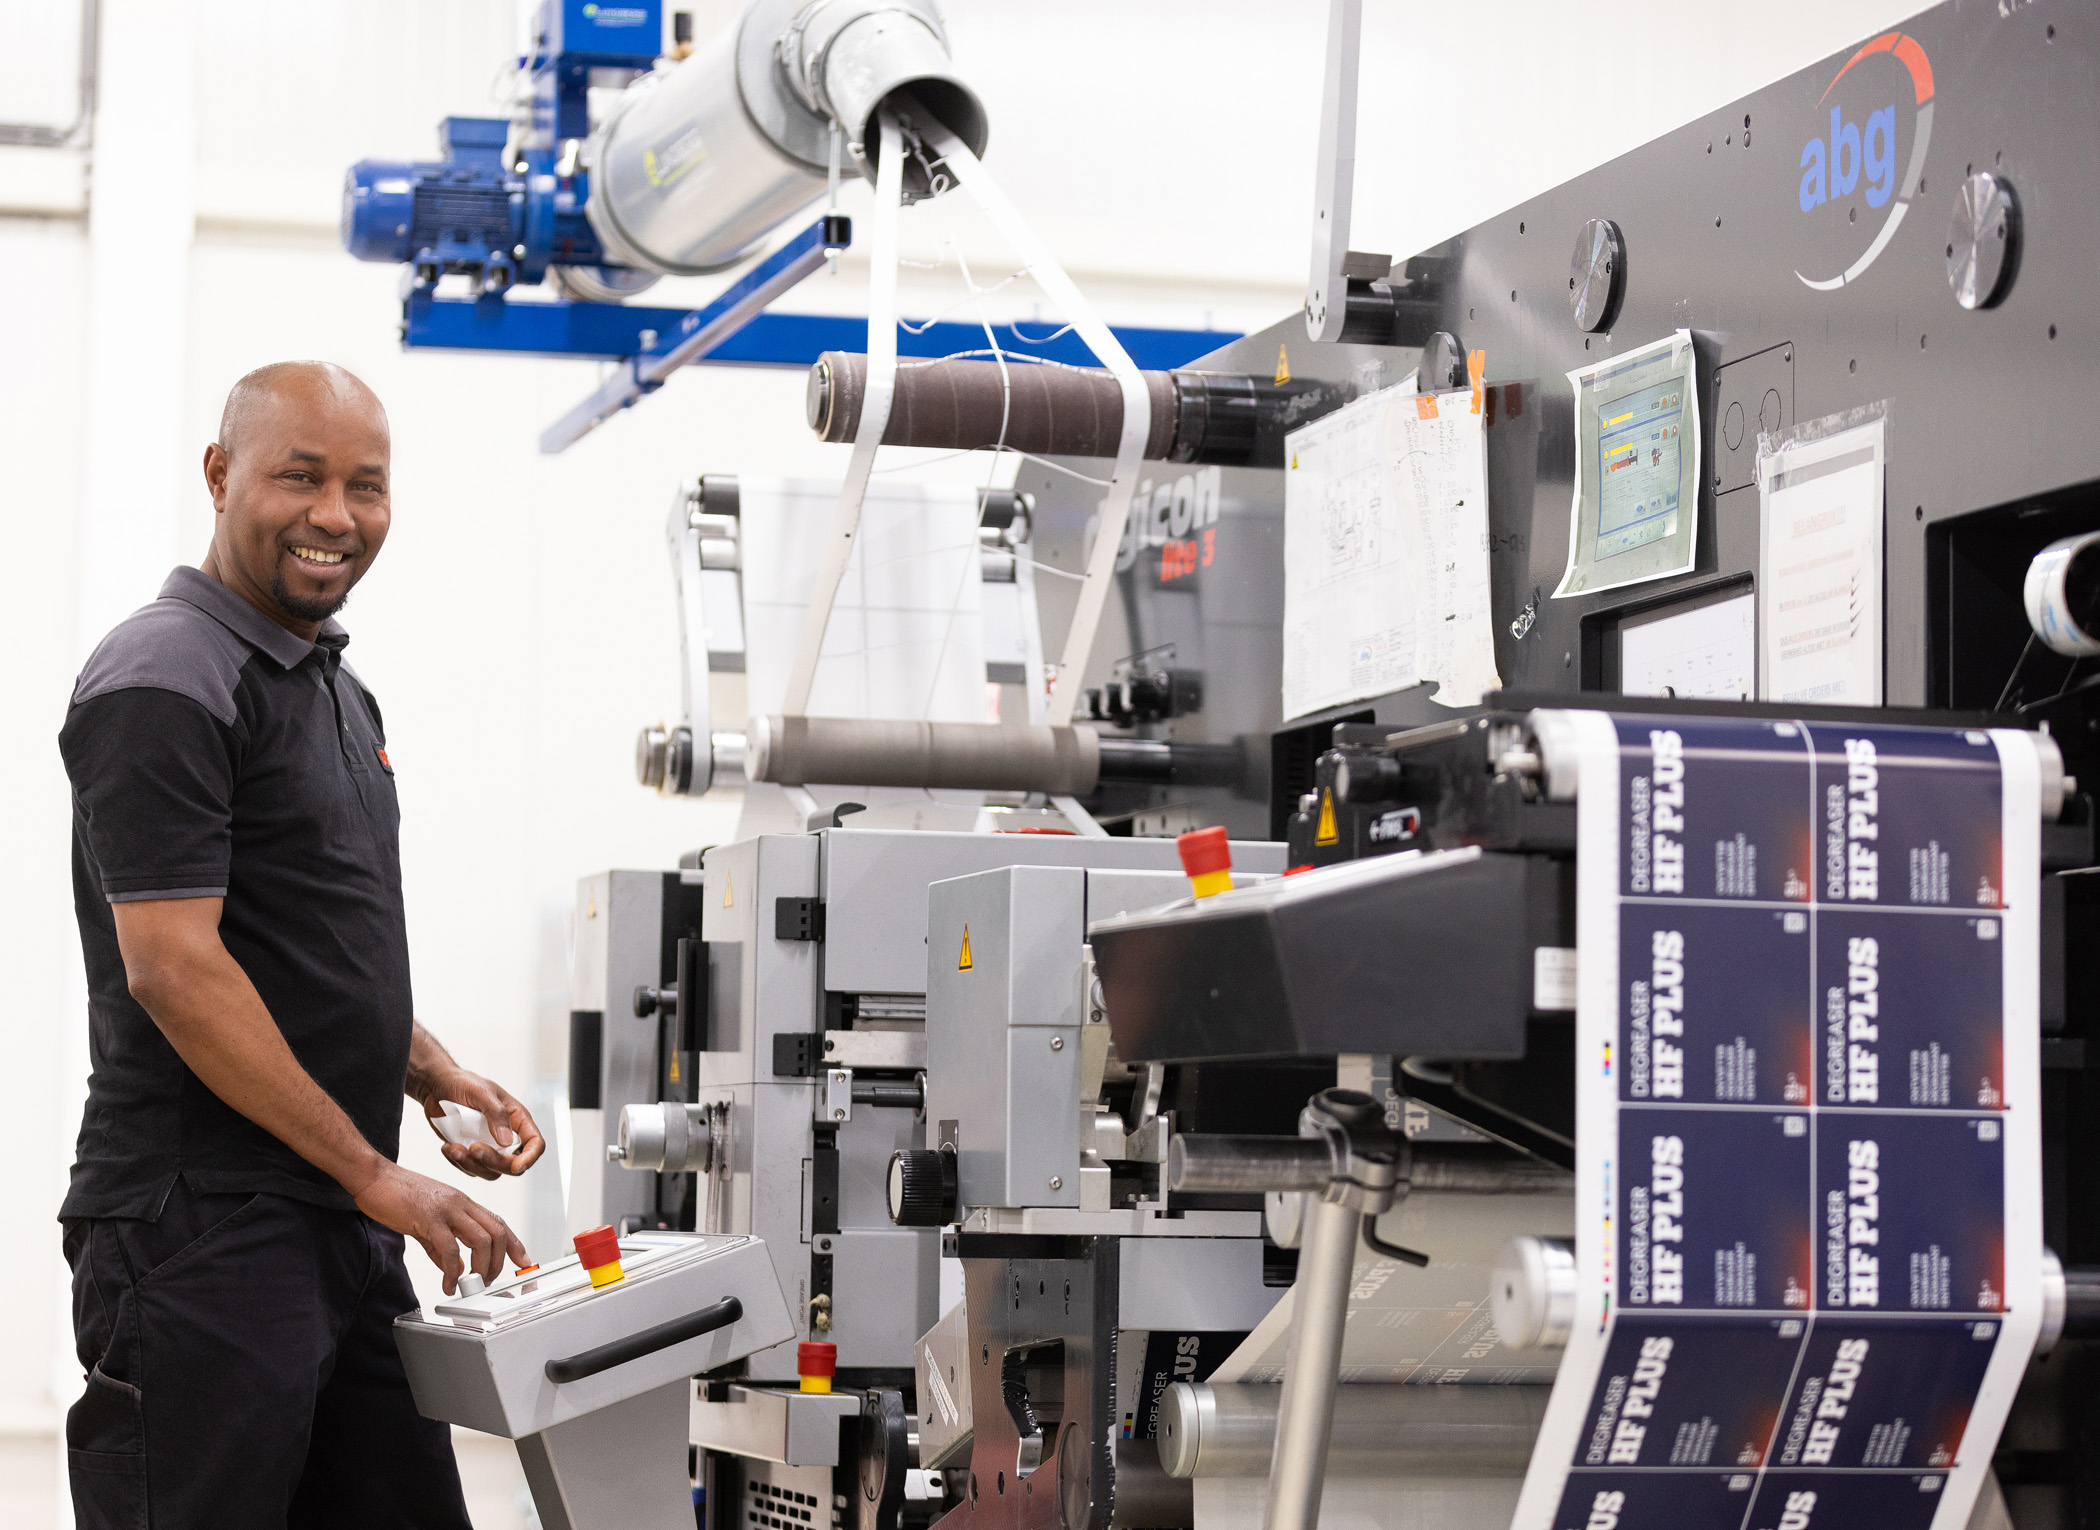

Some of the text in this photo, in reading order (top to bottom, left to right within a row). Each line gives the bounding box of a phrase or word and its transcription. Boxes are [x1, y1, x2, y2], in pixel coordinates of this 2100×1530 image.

[1799, 104, 1896, 213] abg
[1160, 528, 1216, 582] lite 3
[1632, 776, 1650, 892] DEGREASER
[1650, 730, 1684, 893] HF PLUS
[1827, 784, 1845, 899] DEGREASER
[1844, 738, 1878, 901] HF PLUS
[1631, 980, 1649, 1097] DEGREASER
[1652, 930, 1684, 1098] HF PLUS
[1827, 987, 1845, 1102] DEGREASER
[1848, 937, 1879, 1103] HF PLUS
[1630, 1186, 1649, 1303] DEGREASER
[1652, 1135, 1684, 1304] HF PLUS
[1827, 1190, 1846, 1306] DEGREASER
[1848, 1140, 1879, 1307] HF PLUS
[1147, 1371, 1167, 1438] EGREASER
[1586, 1375, 1629, 1464] DEGREASER
[1607, 1336, 1674, 1464] HF PLUS
[1780, 1376, 1824, 1465] DEGREASER
[1801, 1338, 1869, 1465] HF PLUS
[1585, 1490, 1626, 1530] US
[1777, 1491, 1818, 1530] US
